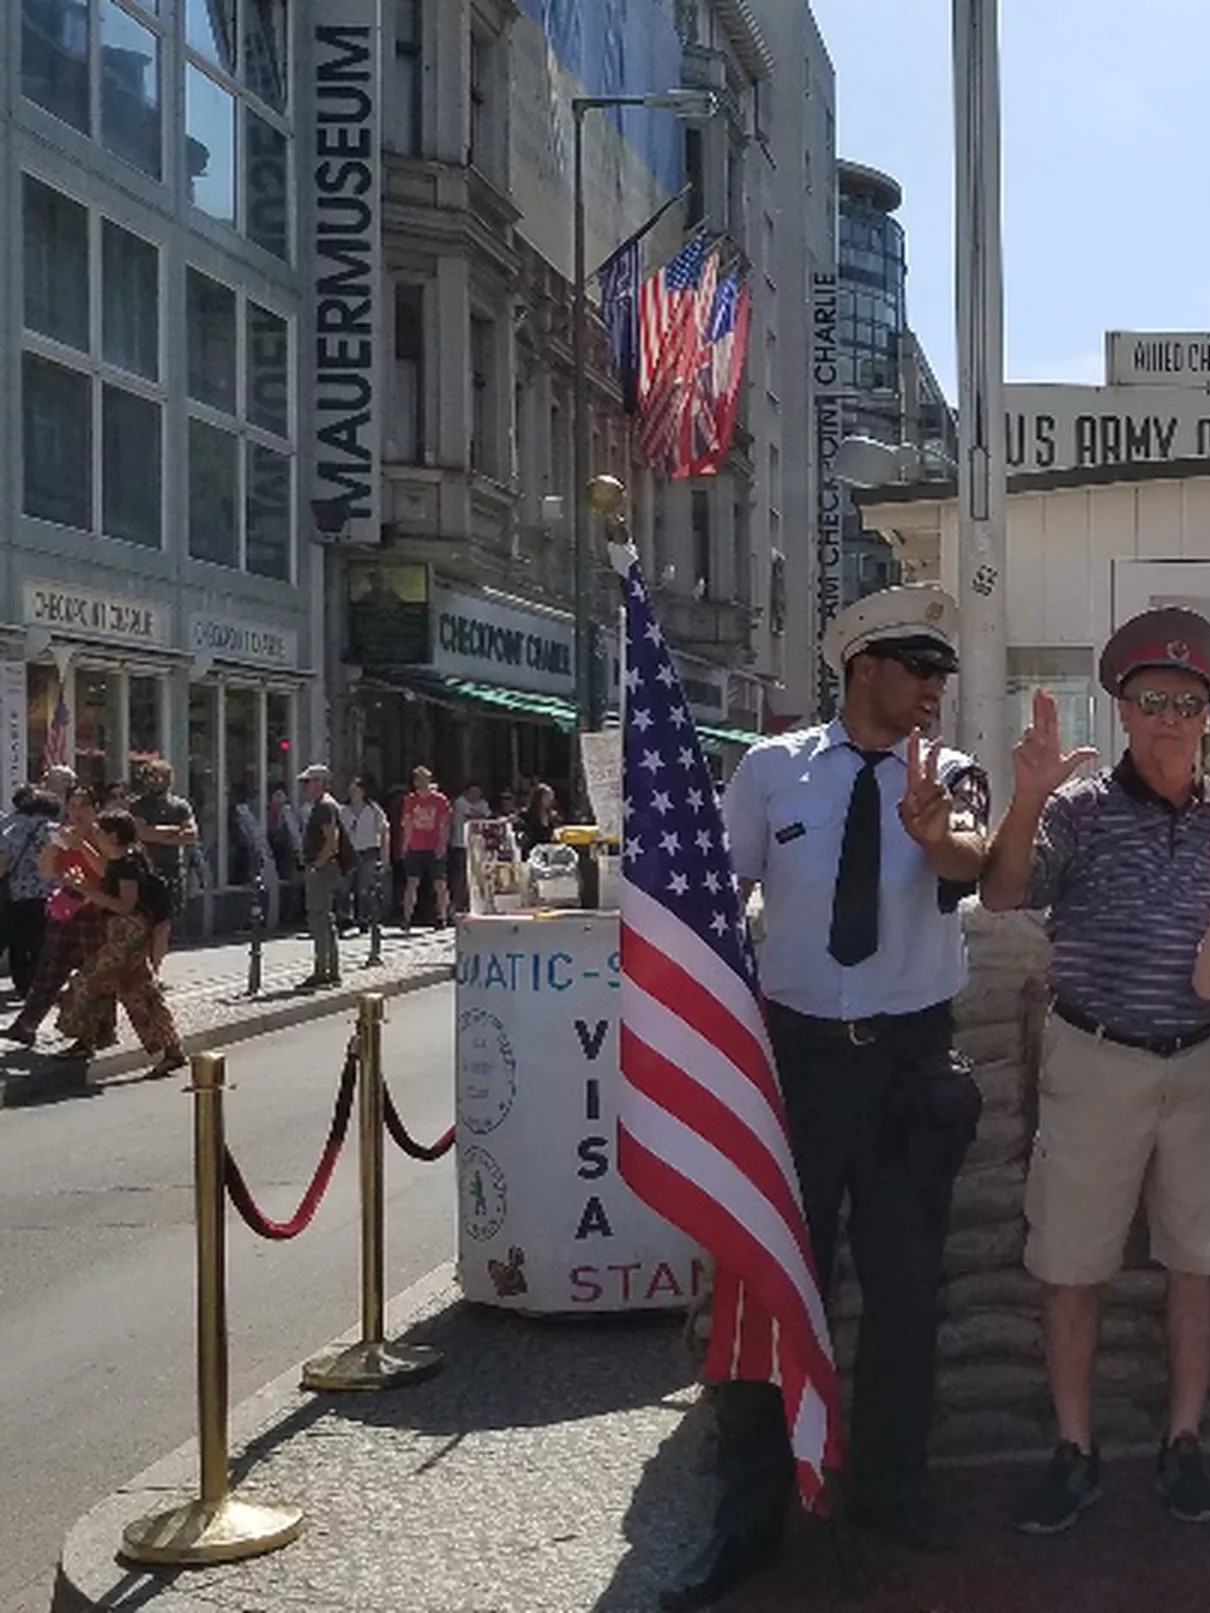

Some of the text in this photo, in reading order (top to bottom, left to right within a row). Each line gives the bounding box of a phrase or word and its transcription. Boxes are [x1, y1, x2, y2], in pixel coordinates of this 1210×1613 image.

[314, 25, 372, 518] MAUERMUSEUM
[814, 271, 837, 385] CHARLIE
[1134, 341, 1183, 372] ALLIED
[1005, 412, 1055, 466] US
[1075, 414, 1177, 463] ARMY
[574, 1020, 613, 1239] VISA
